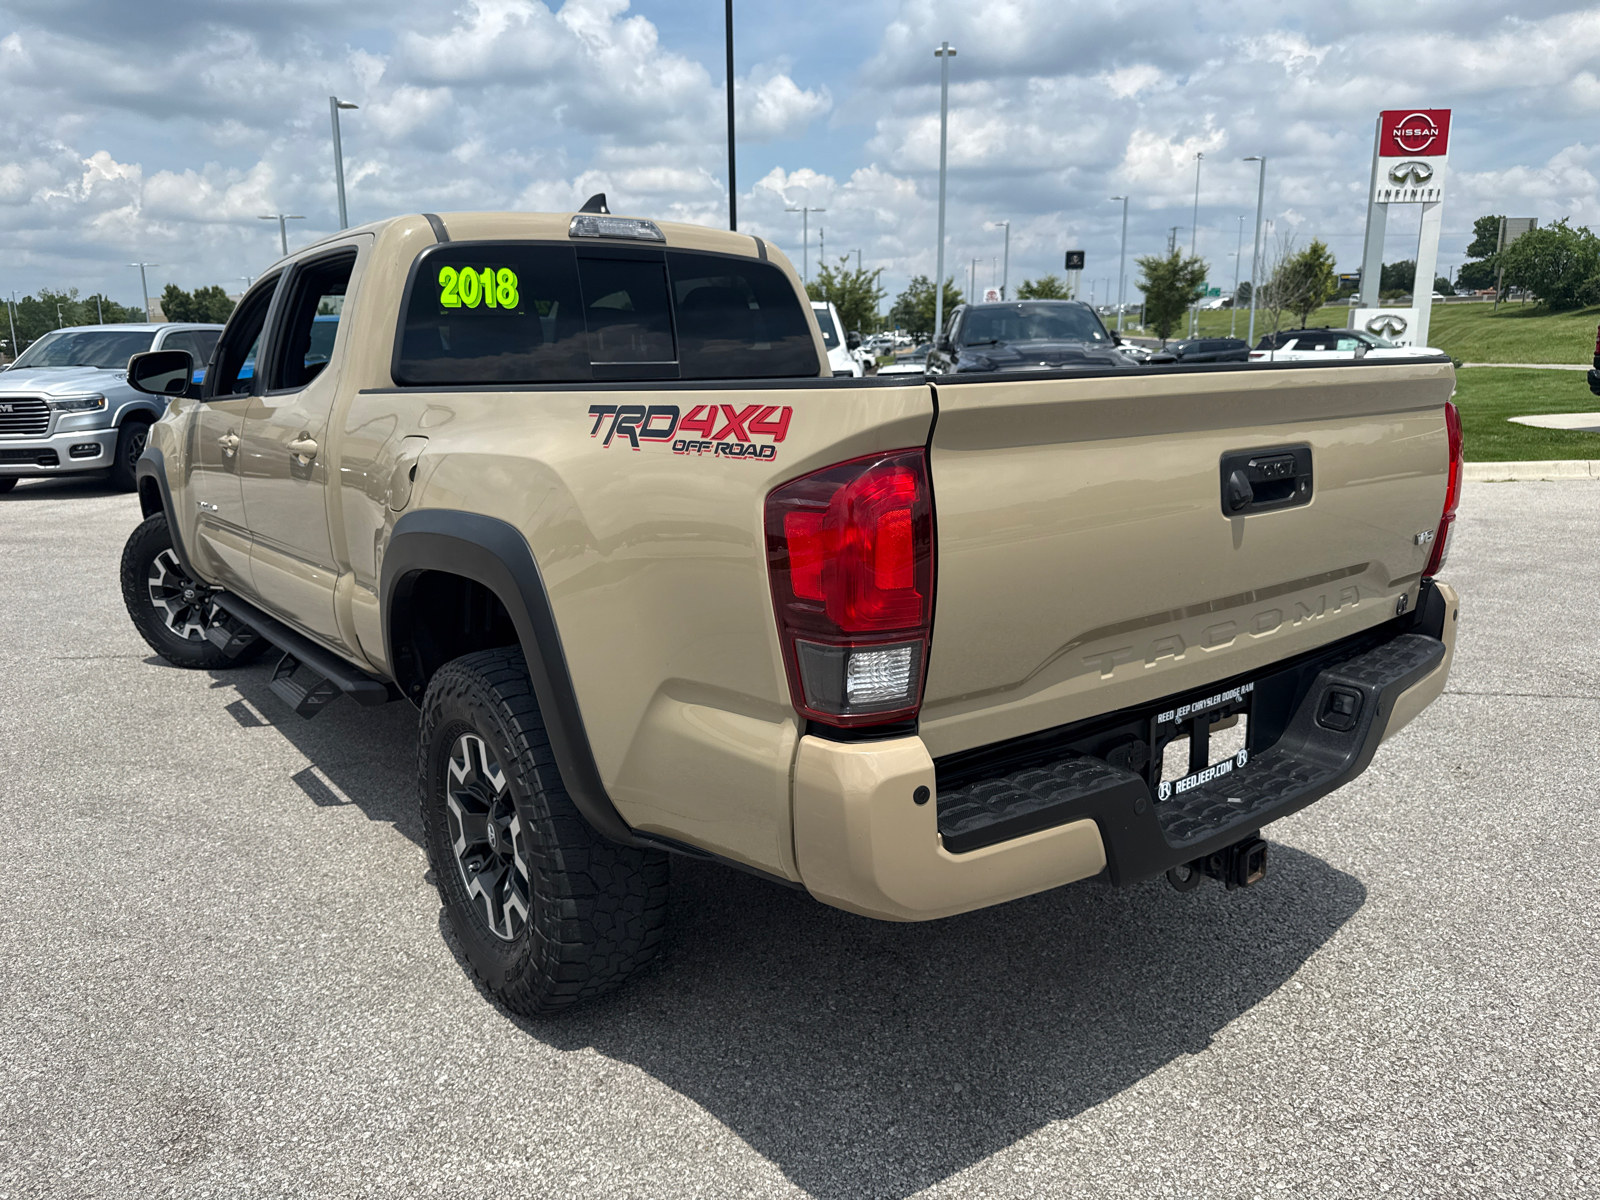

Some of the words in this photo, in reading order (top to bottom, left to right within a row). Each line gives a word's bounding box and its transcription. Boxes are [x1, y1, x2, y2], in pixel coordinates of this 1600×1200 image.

[1392, 128, 1438, 136] NISSAN
[1377, 188, 1441, 198] INFINITI
[438, 265, 519, 310] 2018
[588, 404, 682, 452] TRD
[678, 403, 794, 443] 4X4
[672, 439, 715, 457] OFF
[714, 441, 778, 463] ROAD
[1081, 584, 1361, 681] TACOMA
[1157, 710, 1175, 724] REED
[1175, 704, 1191, 718] JEEP
[1191, 694, 1222, 712] CHRYSLER
[1221, 687, 1241, 701] DODGE
[1240, 682, 1254, 695] RAM
[1175, 759, 1233, 795] REEDJEEP.COM
